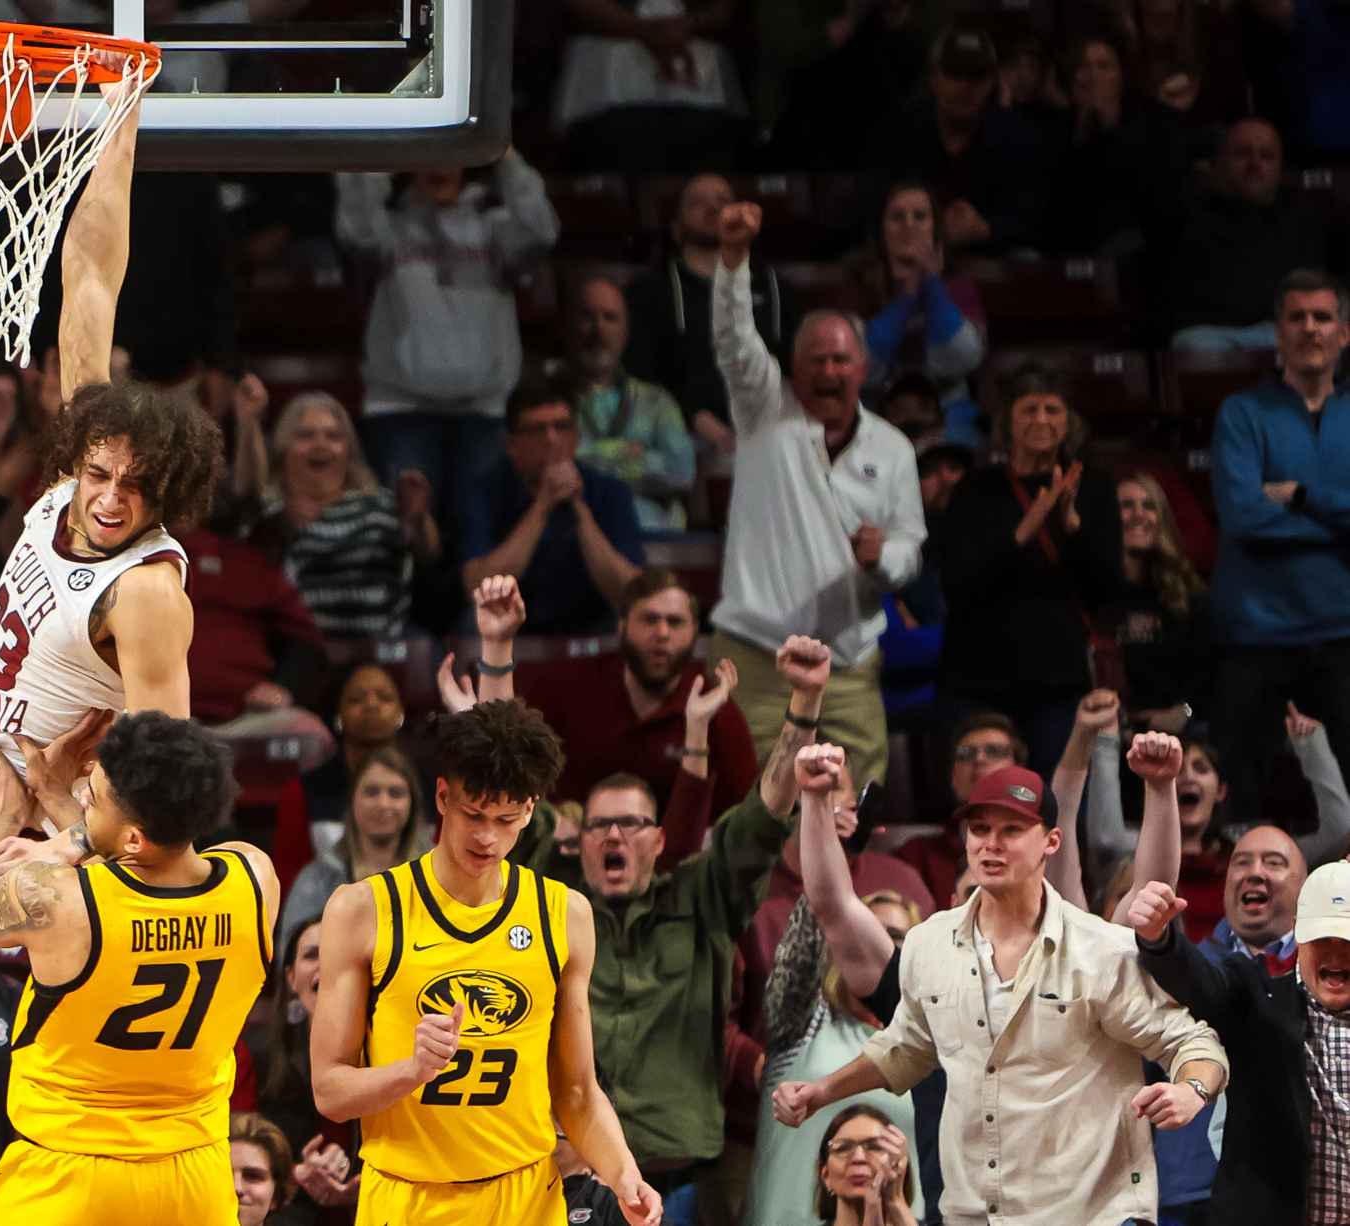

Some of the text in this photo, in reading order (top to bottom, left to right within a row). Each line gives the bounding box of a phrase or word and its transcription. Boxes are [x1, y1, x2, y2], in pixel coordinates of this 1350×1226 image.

[4, 542, 57, 638] SOUTH
[131, 913, 232, 952] DEGRAY III
[509, 926, 532, 950] SEC
[95, 957, 227, 1051] 21
[419, 1048, 518, 1106] 23
